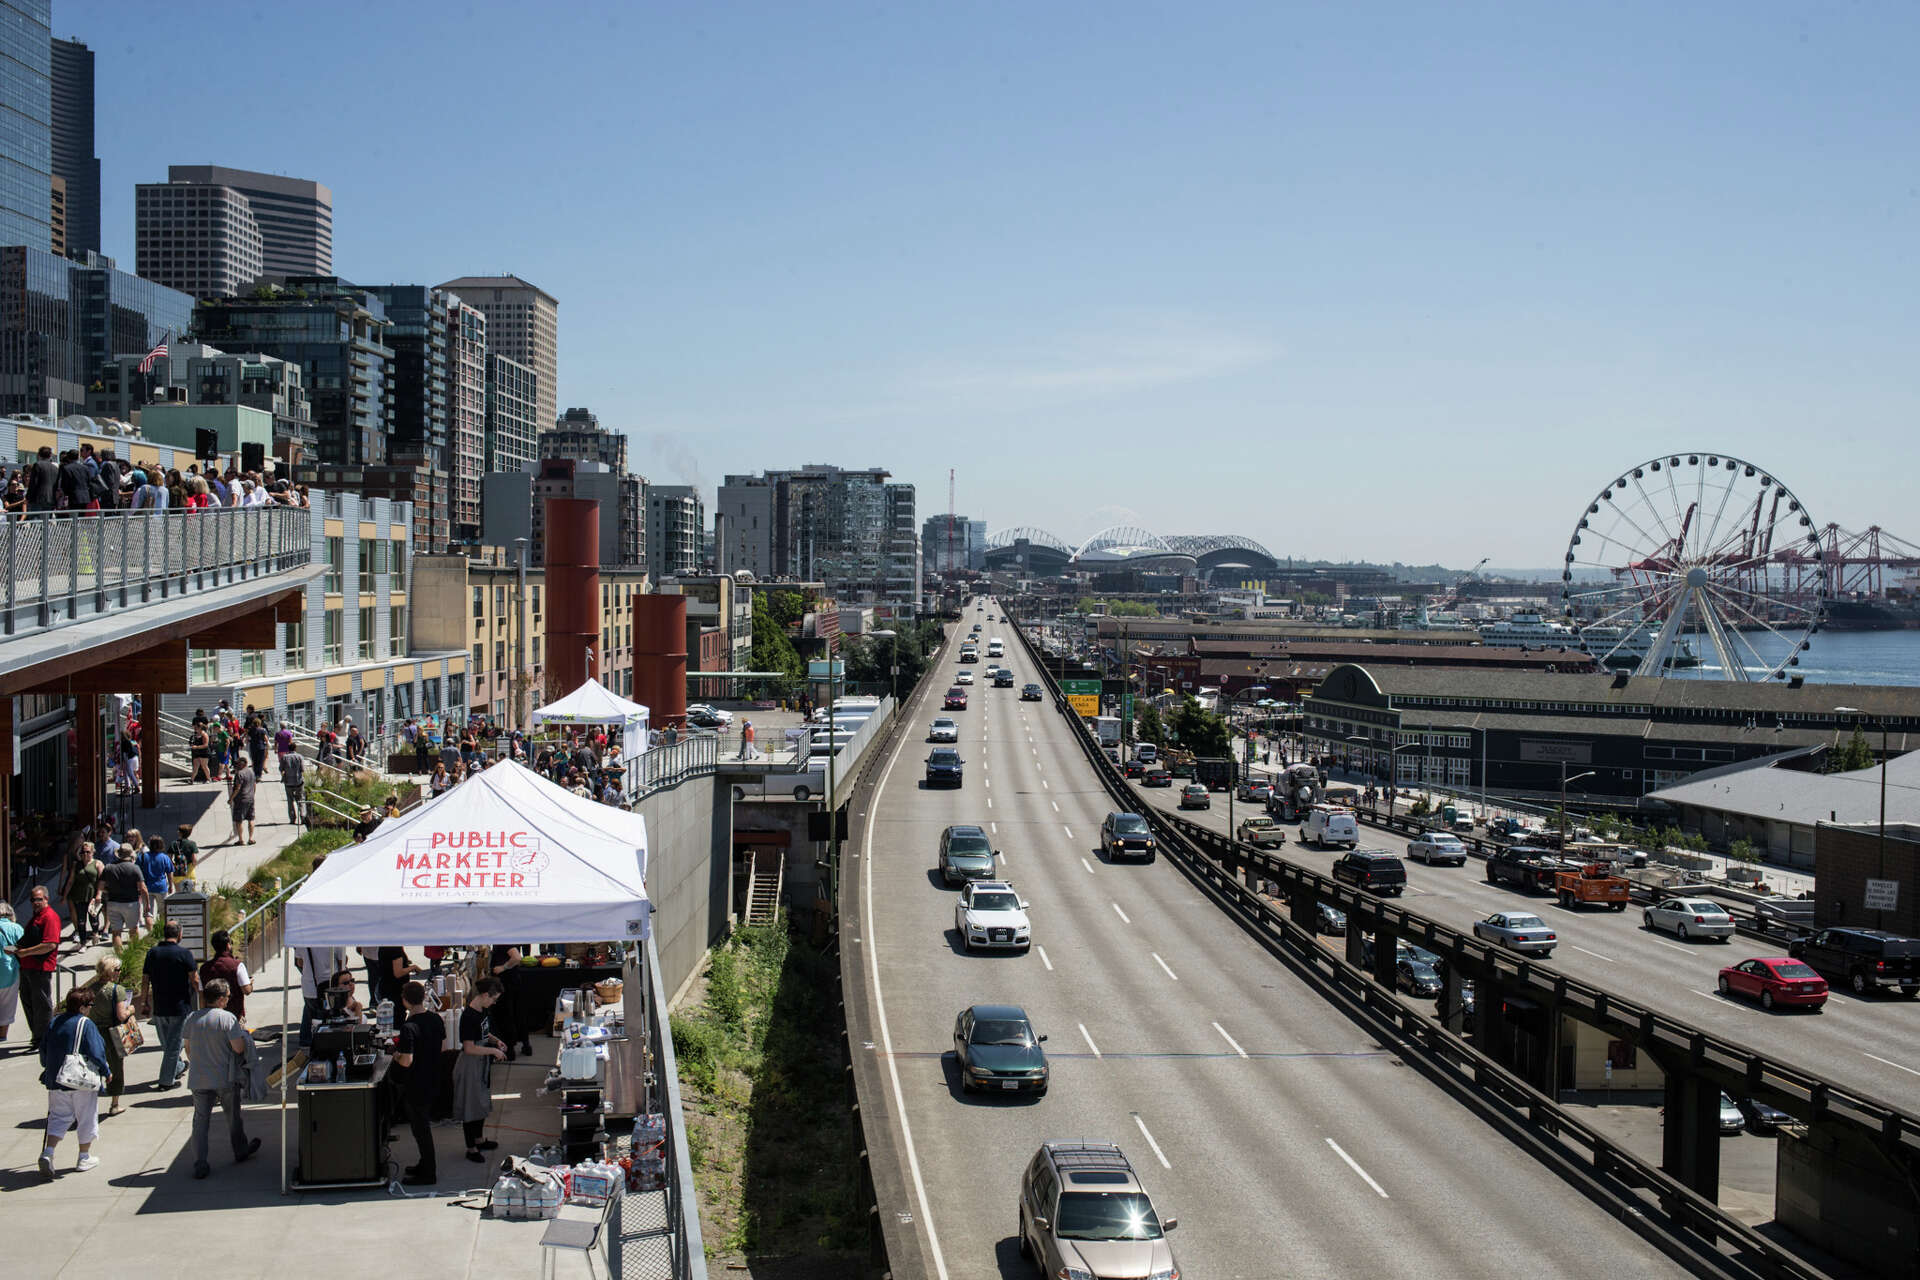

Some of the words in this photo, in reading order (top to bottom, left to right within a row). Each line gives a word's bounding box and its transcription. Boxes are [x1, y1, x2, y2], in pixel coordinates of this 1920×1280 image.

[432, 831, 528, 849] PUBLIC
[396, 852, 508, 870] MARKET
[412, 872, 525, 889] CENTER
[437, 890, 479, 898] PLACE
[484, 889, 541, 897] MARKET
